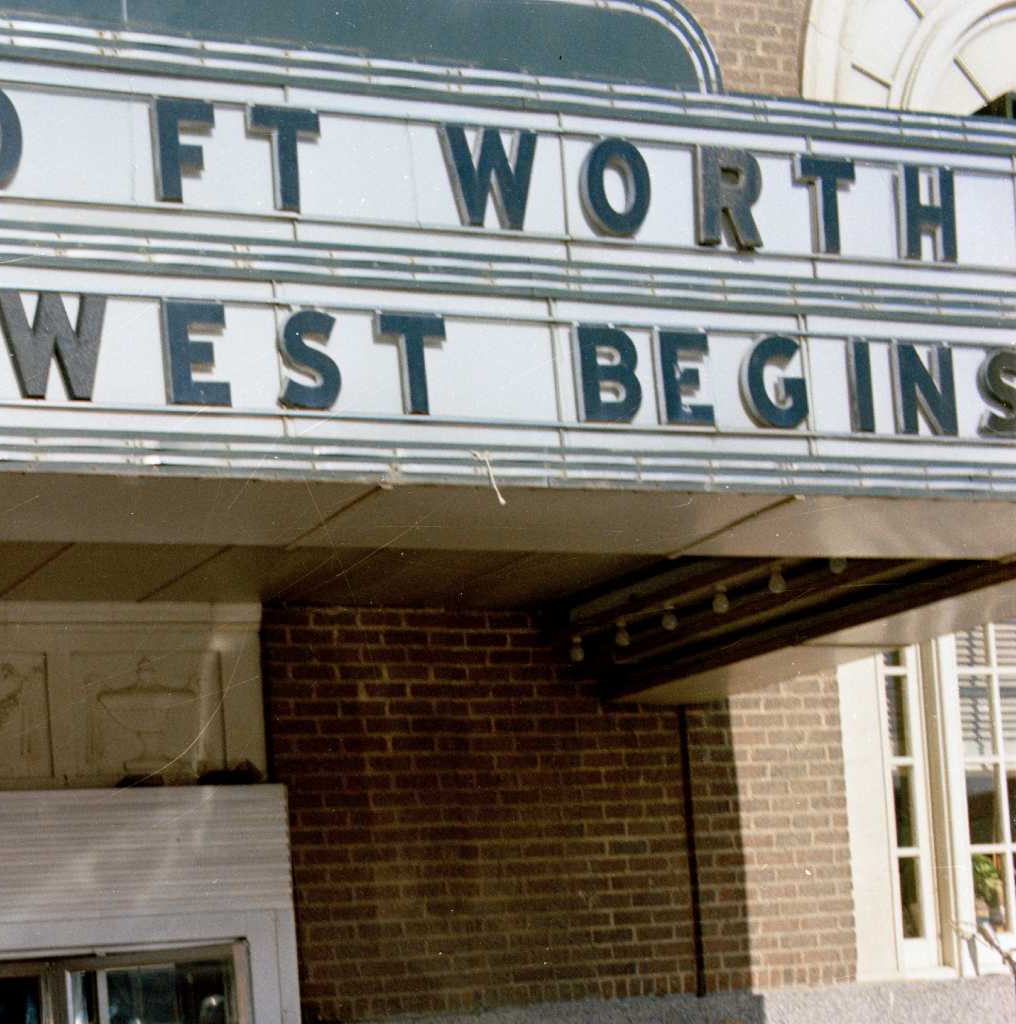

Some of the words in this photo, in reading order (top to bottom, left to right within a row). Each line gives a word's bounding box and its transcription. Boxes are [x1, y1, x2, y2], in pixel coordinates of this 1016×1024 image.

[150, 94, 321, 213] FT
[438, 122, 957, 263] WORTH
[572, 322, 1016, 439] BEGINS
